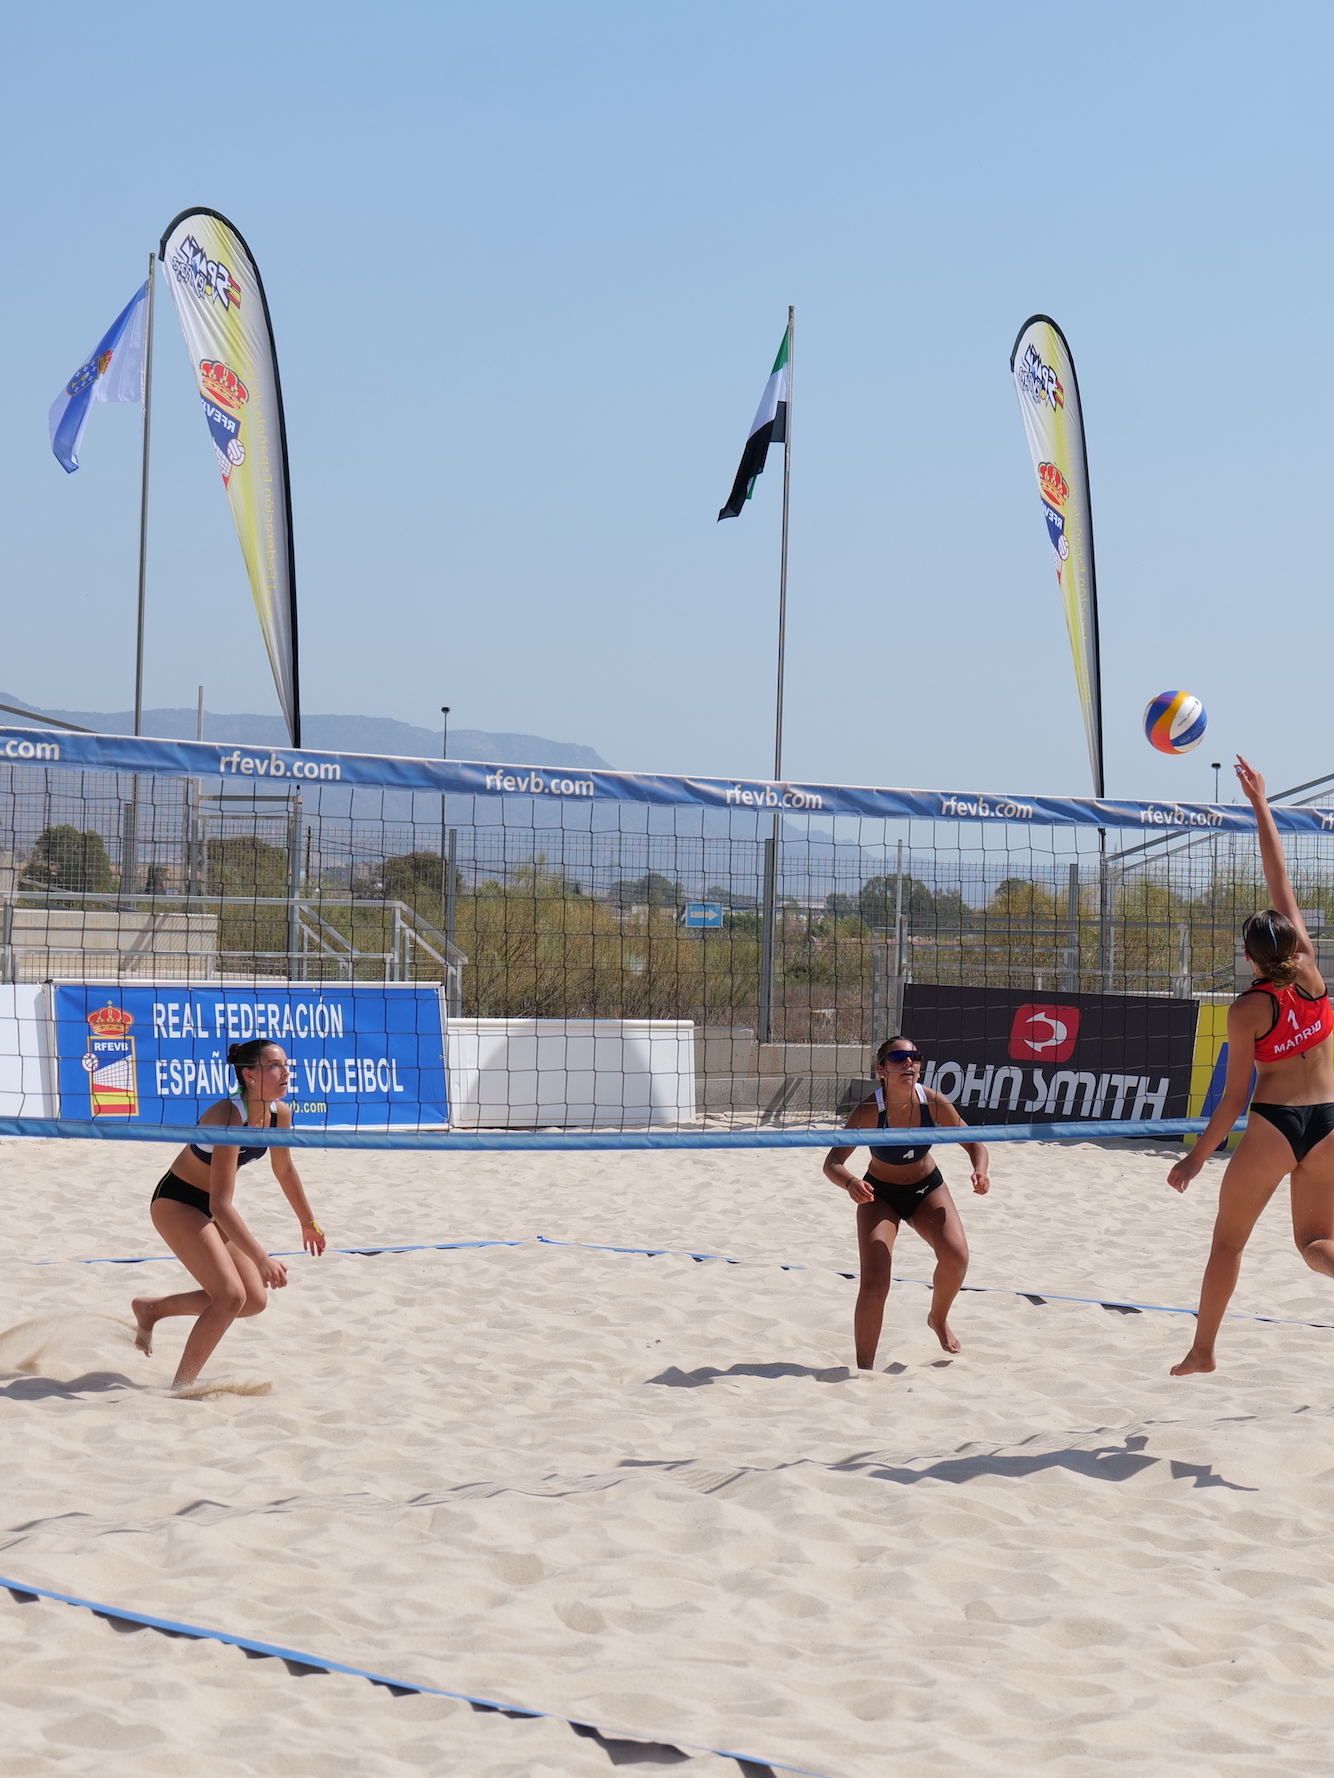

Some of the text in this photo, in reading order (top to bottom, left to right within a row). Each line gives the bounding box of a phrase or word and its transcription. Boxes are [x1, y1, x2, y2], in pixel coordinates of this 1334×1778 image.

[219, 750, 342, 781] rfevb.com
[485, 769, 595, 796] rfevb.com
[725, 784, 823, 810] rfevb.com
[941, 796, 1033, 820] rfevb.com
[1139, 805, 1223, 827] rfevb.com
[153, 996, 344, 1039] REAL FEDERACIÓN
[1287, 1008, 1299, 1030] 1
[93, 1041, 129, 1052] RFEVB
[1273, 1019, 1323, 1055] MADRID
[155, 1050, 404, 1096] ESPAÑO E VOLEIBOL
[923, 1060, 1171, 1121] JOHN SMITH
